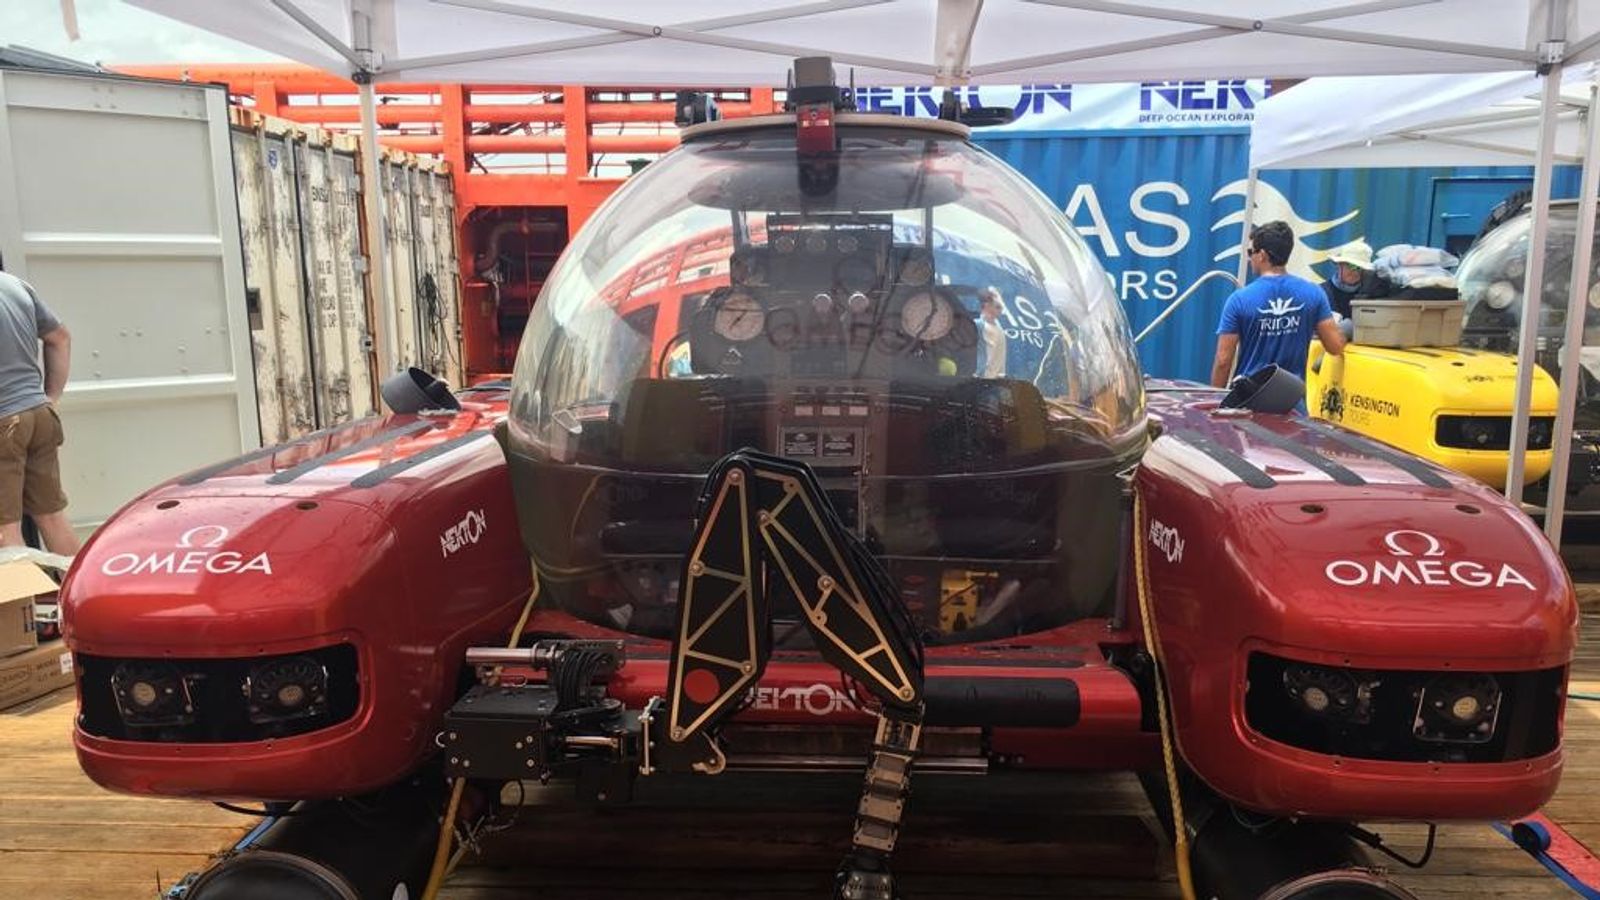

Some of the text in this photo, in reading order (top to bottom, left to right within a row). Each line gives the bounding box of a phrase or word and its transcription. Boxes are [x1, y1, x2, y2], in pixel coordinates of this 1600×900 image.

[1140, 80, 1272, 111] NEK
[1105, 269, 1178, 300] RS
[1259, 316, 1301, 330] TRITON
[1350, 395, 1400, 417] KENSINGTON
[440, 509, 487, 558] NEKTON
[1149, 518, 1185, 563] NEKTON
[102, 551, 272, 575] OMEGA
[1325, 560, 1537, 591] OMEGA
